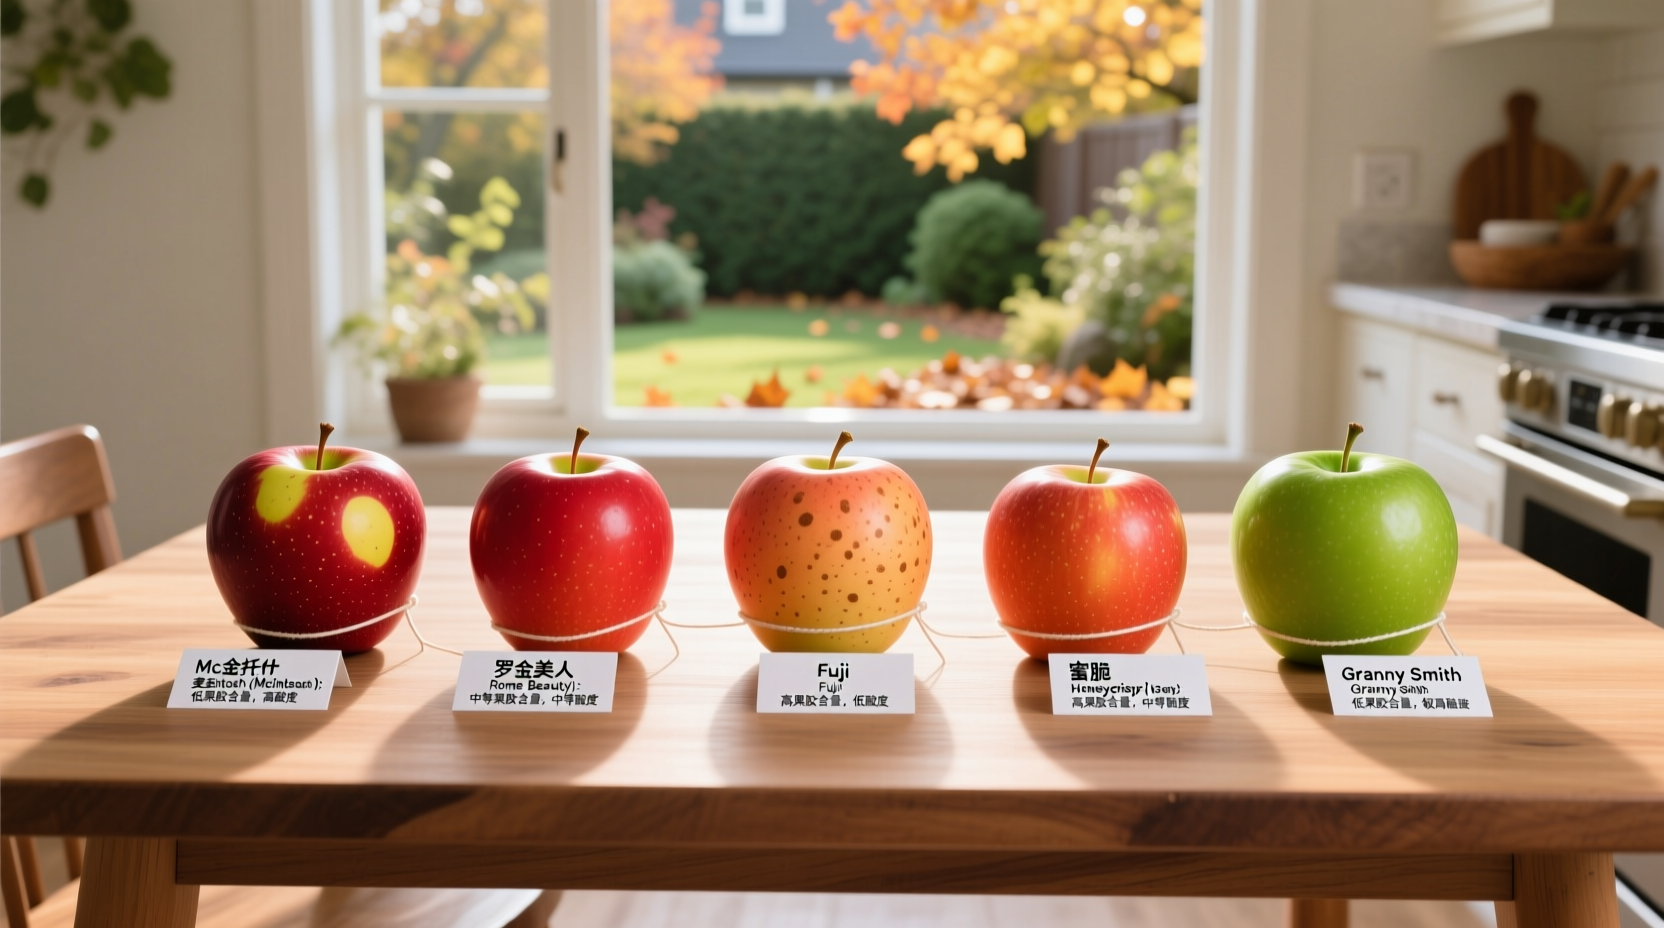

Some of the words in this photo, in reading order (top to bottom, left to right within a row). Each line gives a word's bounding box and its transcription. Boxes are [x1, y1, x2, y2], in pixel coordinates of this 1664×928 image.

[494, 659, 574, 679] 罗金美人
[817, 662, 849, 682] Fuji
[1341, 666, 1405, 685] Granny
[1410, 666, 1462, 682] Smith
[489, 679, 524, 692] Rome
